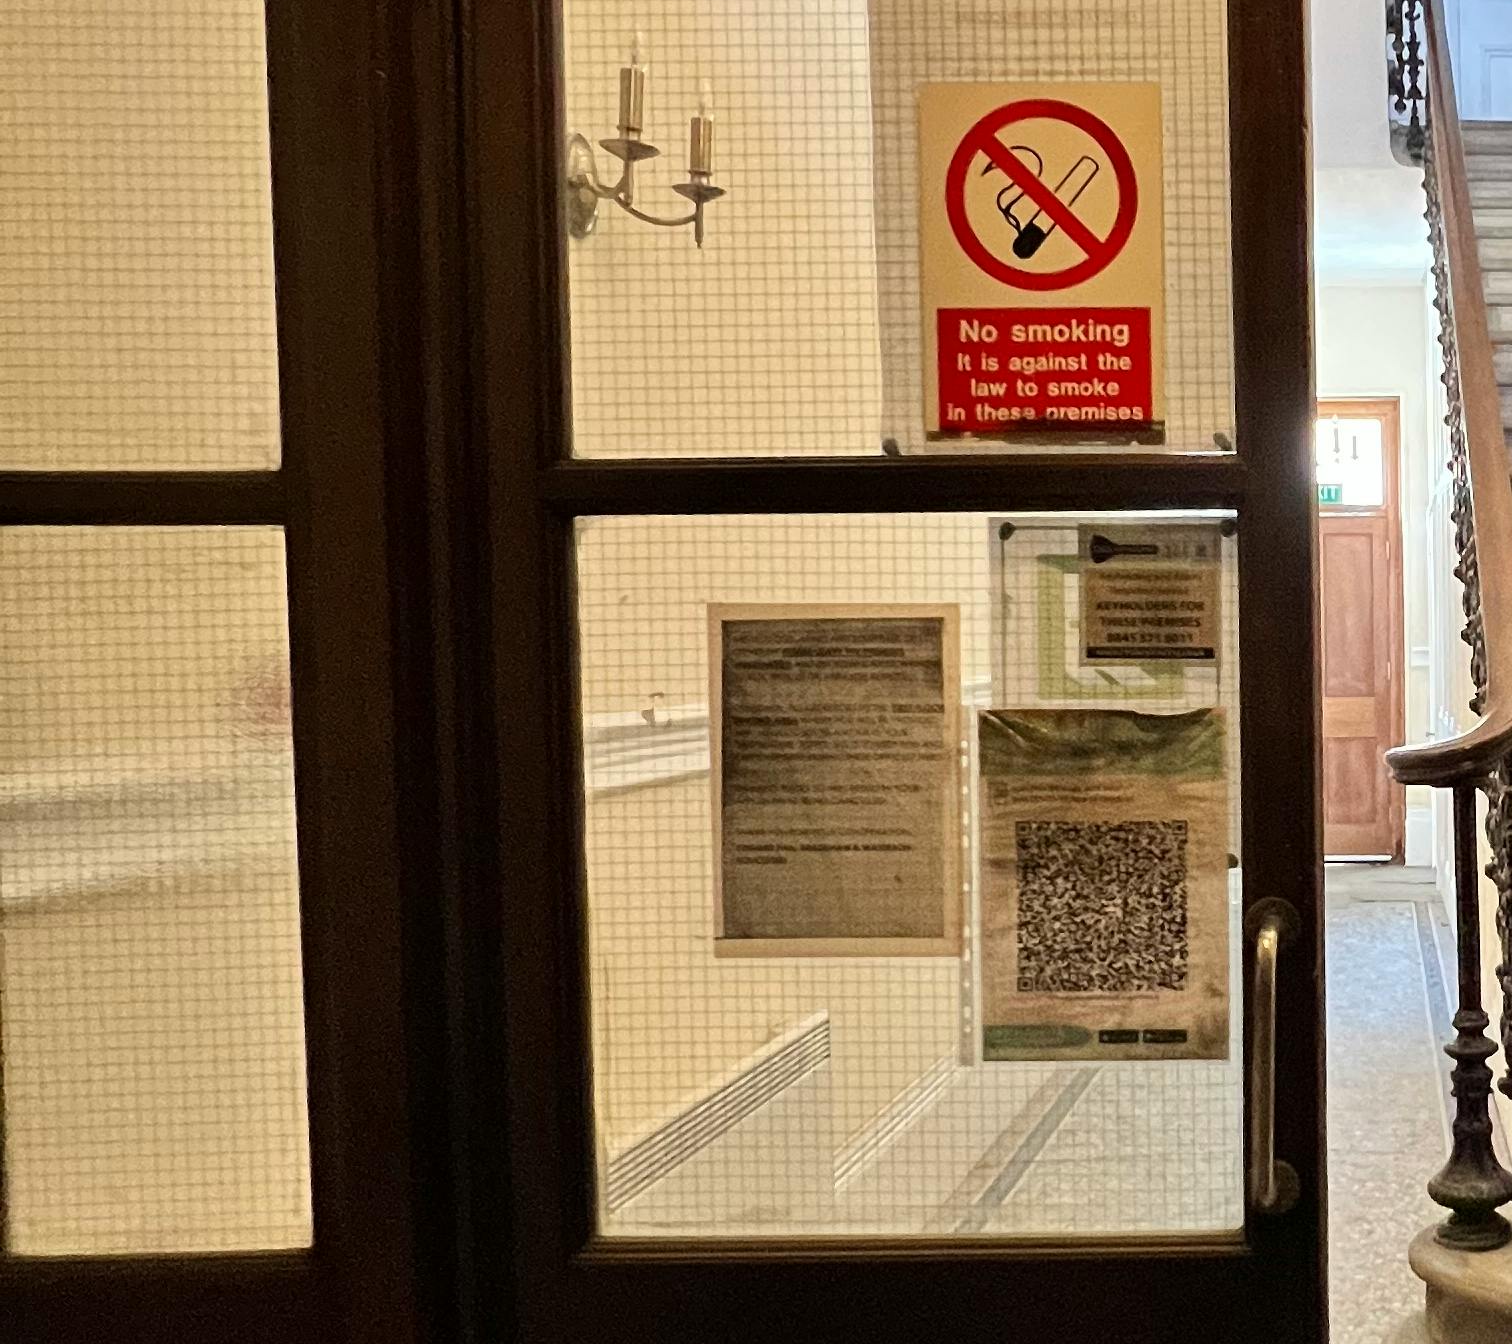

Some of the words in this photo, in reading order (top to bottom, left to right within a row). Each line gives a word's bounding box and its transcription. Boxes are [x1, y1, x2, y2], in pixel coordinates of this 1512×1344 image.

[959, 319, 998, 343] No
[1011, 319, 1130, 347] smoking
[957, 352, 972, 371] It
[981, 352, 999, 371] is
[1008, 352, 1088, 375] against
[1097, 352, 1132, 371] the
[970, 378, 1008, 397] law
[1016, 378, 1039, 397] to
[1047, 378, 1120, 397] smoke
[975, 403, 1036, 422] these
[1045, 402, 1144, 421] premises
